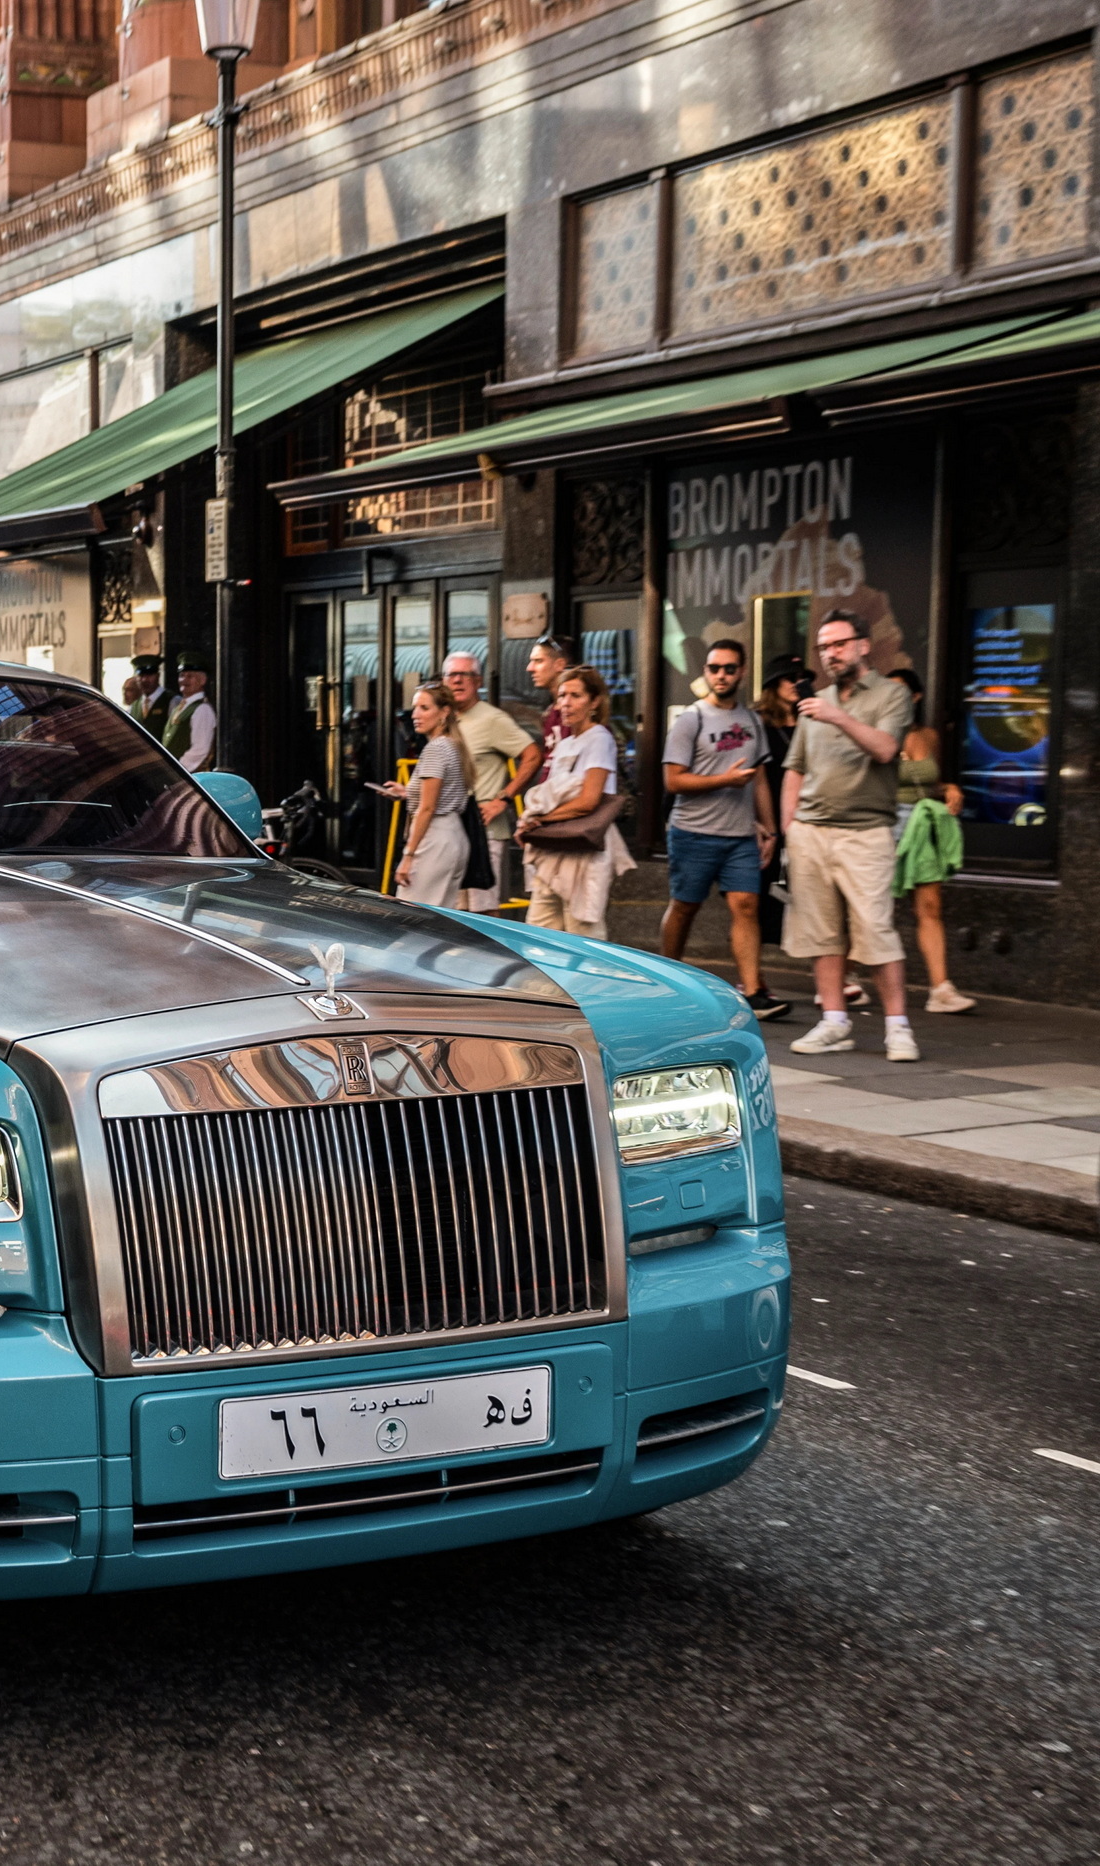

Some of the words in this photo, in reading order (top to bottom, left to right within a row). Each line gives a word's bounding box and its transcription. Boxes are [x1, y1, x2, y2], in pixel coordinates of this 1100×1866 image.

[668, 457, 853, 540] BROMPTON
[668, 532, 863, 608] IMMORTALS
[349, 1083, 370, 1091] ROYCE
[350, 1388, 435, 1416] السعودية
[270, 1406, 326, 1460] ٦٦
